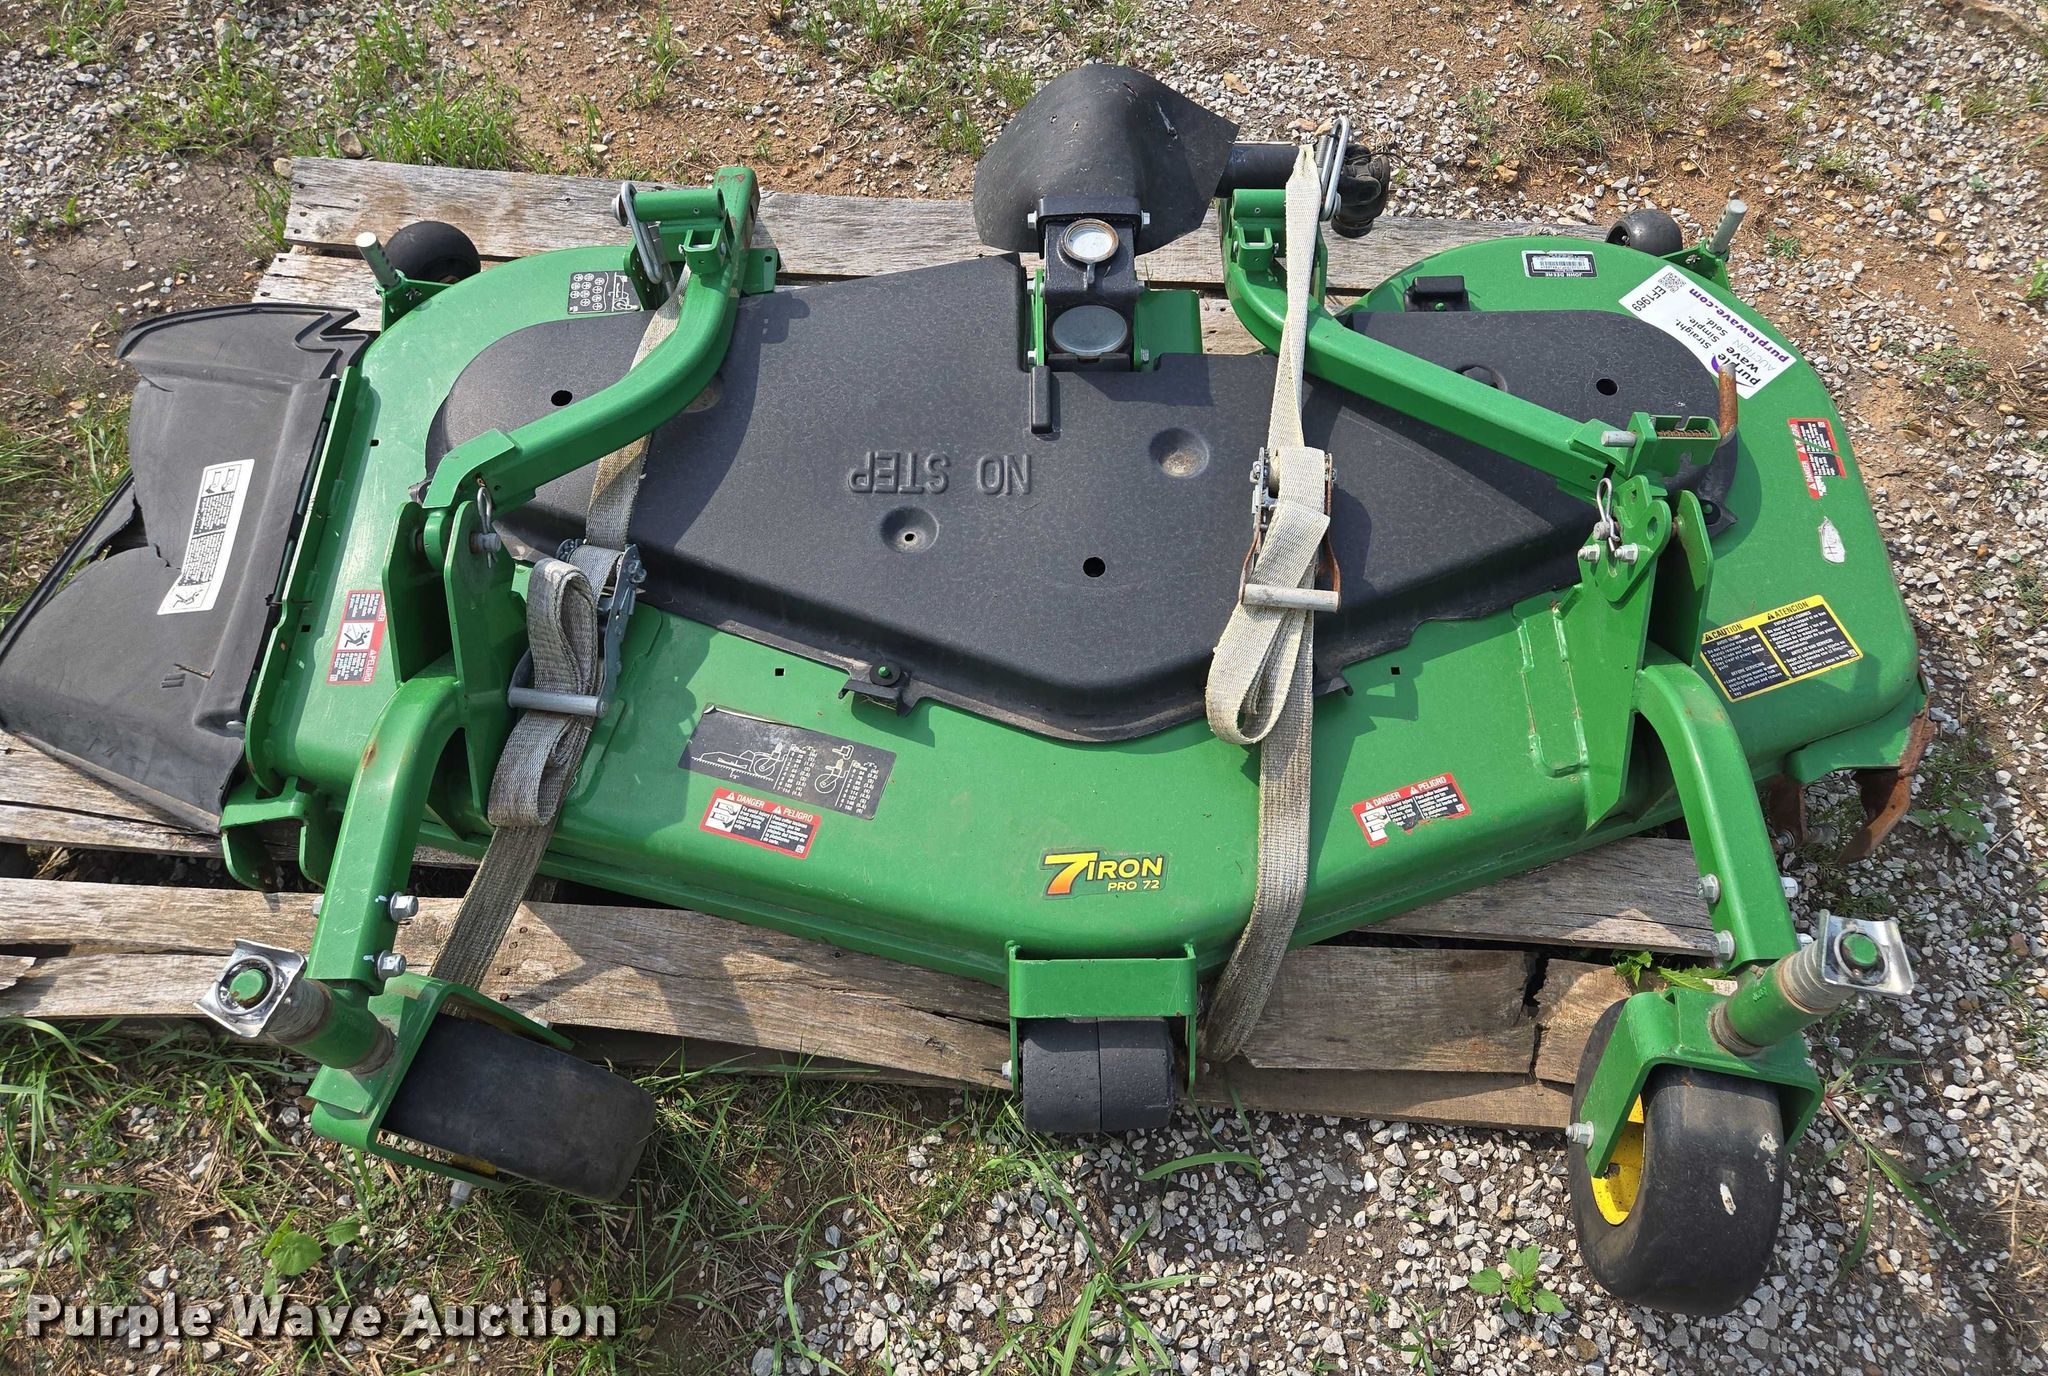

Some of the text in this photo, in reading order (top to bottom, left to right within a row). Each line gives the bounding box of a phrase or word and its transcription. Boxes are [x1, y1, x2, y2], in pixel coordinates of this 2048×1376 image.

[1632, 285, 1666, 312] EF1969
[1675, 319, 1712, 349] Straight.
[1688, 315, 1720, 343] Simple.
[1689, 288, 1789, 363] purplewave.com
[1707, 317, 1728, 337] Sold.
[1726, 346, 1759, 373] wave
[1733, 339, 1776, 371] AUCTION
[848, 451, 1031, 496] NO STEP
[1775, 601, 1809, 617] ATENCION
[1712, 624, 1743, 638] CAUTION
[364, 655, 376, 682] PELIGRO
[1373, 777, 1446, 806] DANGER PELIGRO
[736, 794, 813, 822] DANGER PELIGRO
[1107, 880, 1160, 891] PRO 72
